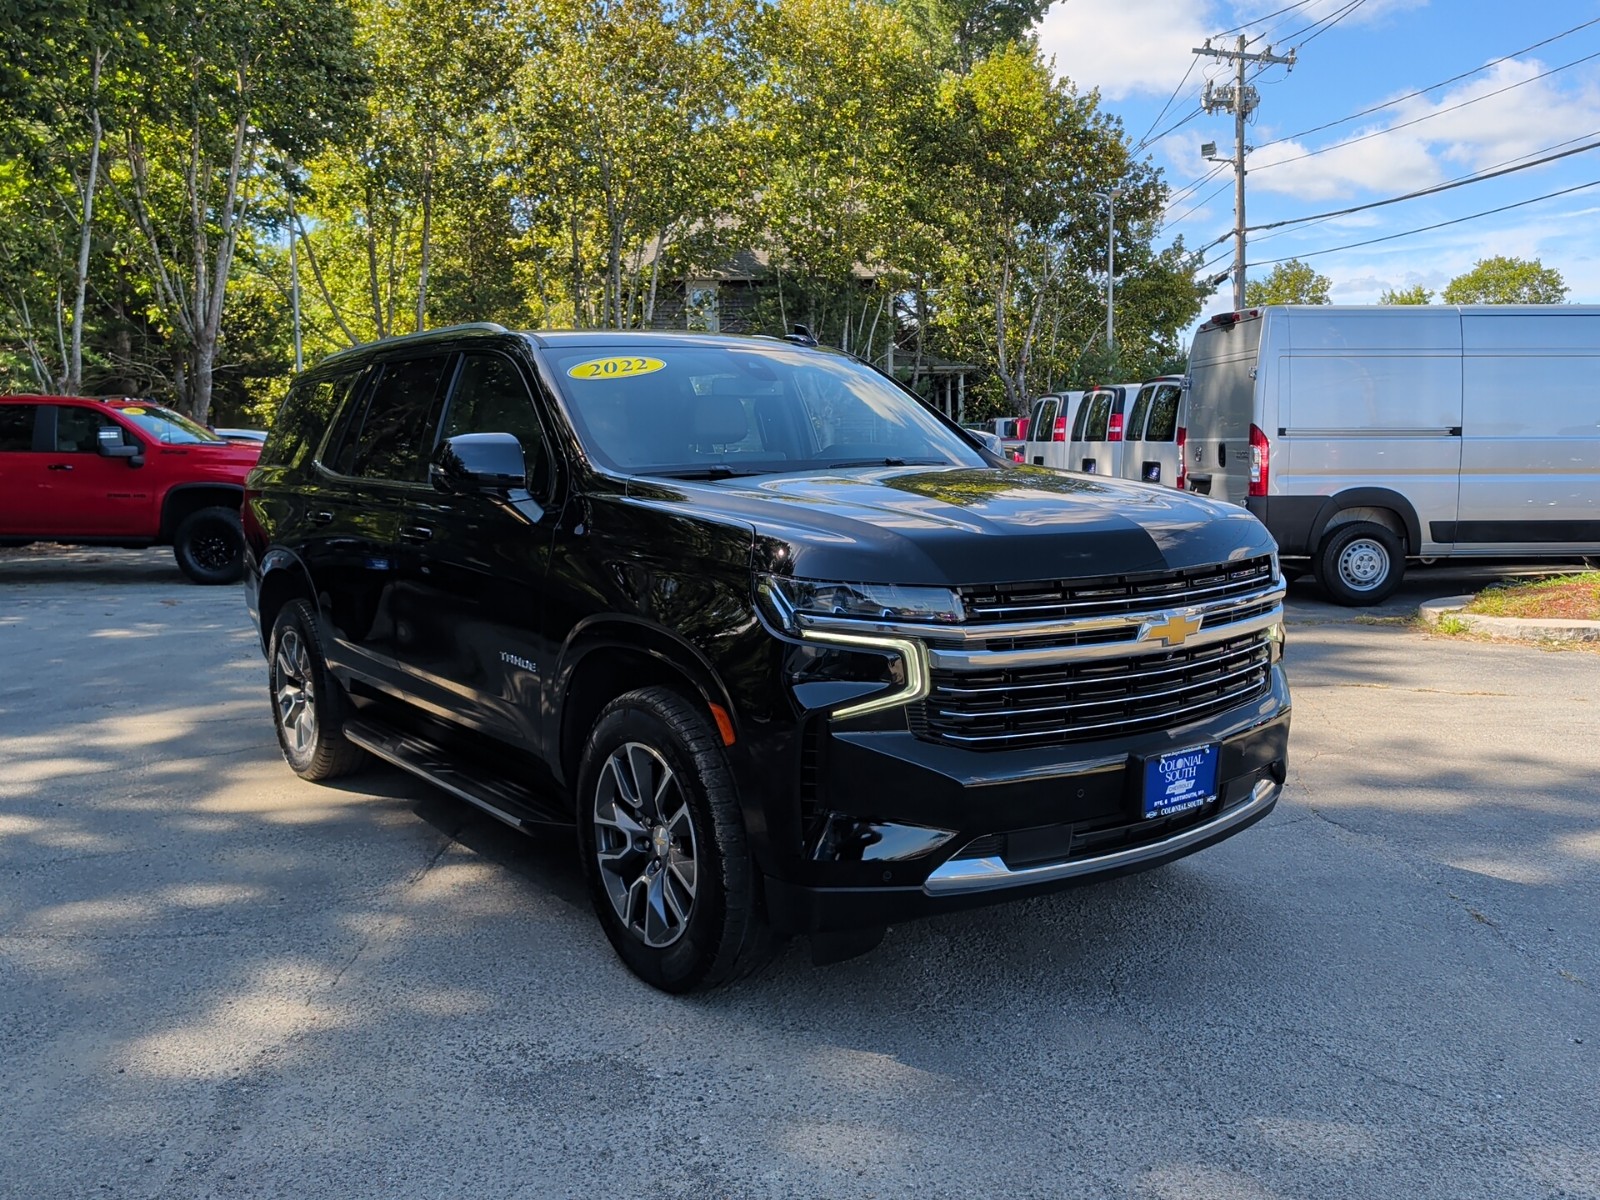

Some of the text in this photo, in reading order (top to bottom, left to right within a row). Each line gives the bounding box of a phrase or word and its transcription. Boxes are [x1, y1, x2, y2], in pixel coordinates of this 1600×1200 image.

[588, 358, 648, 377] 2022
[499, 651, 537, 672] TAHOE
[1158, 754, 1204, 773] COLONIAL
[1165, 766, 1197, 783] SOUTH
